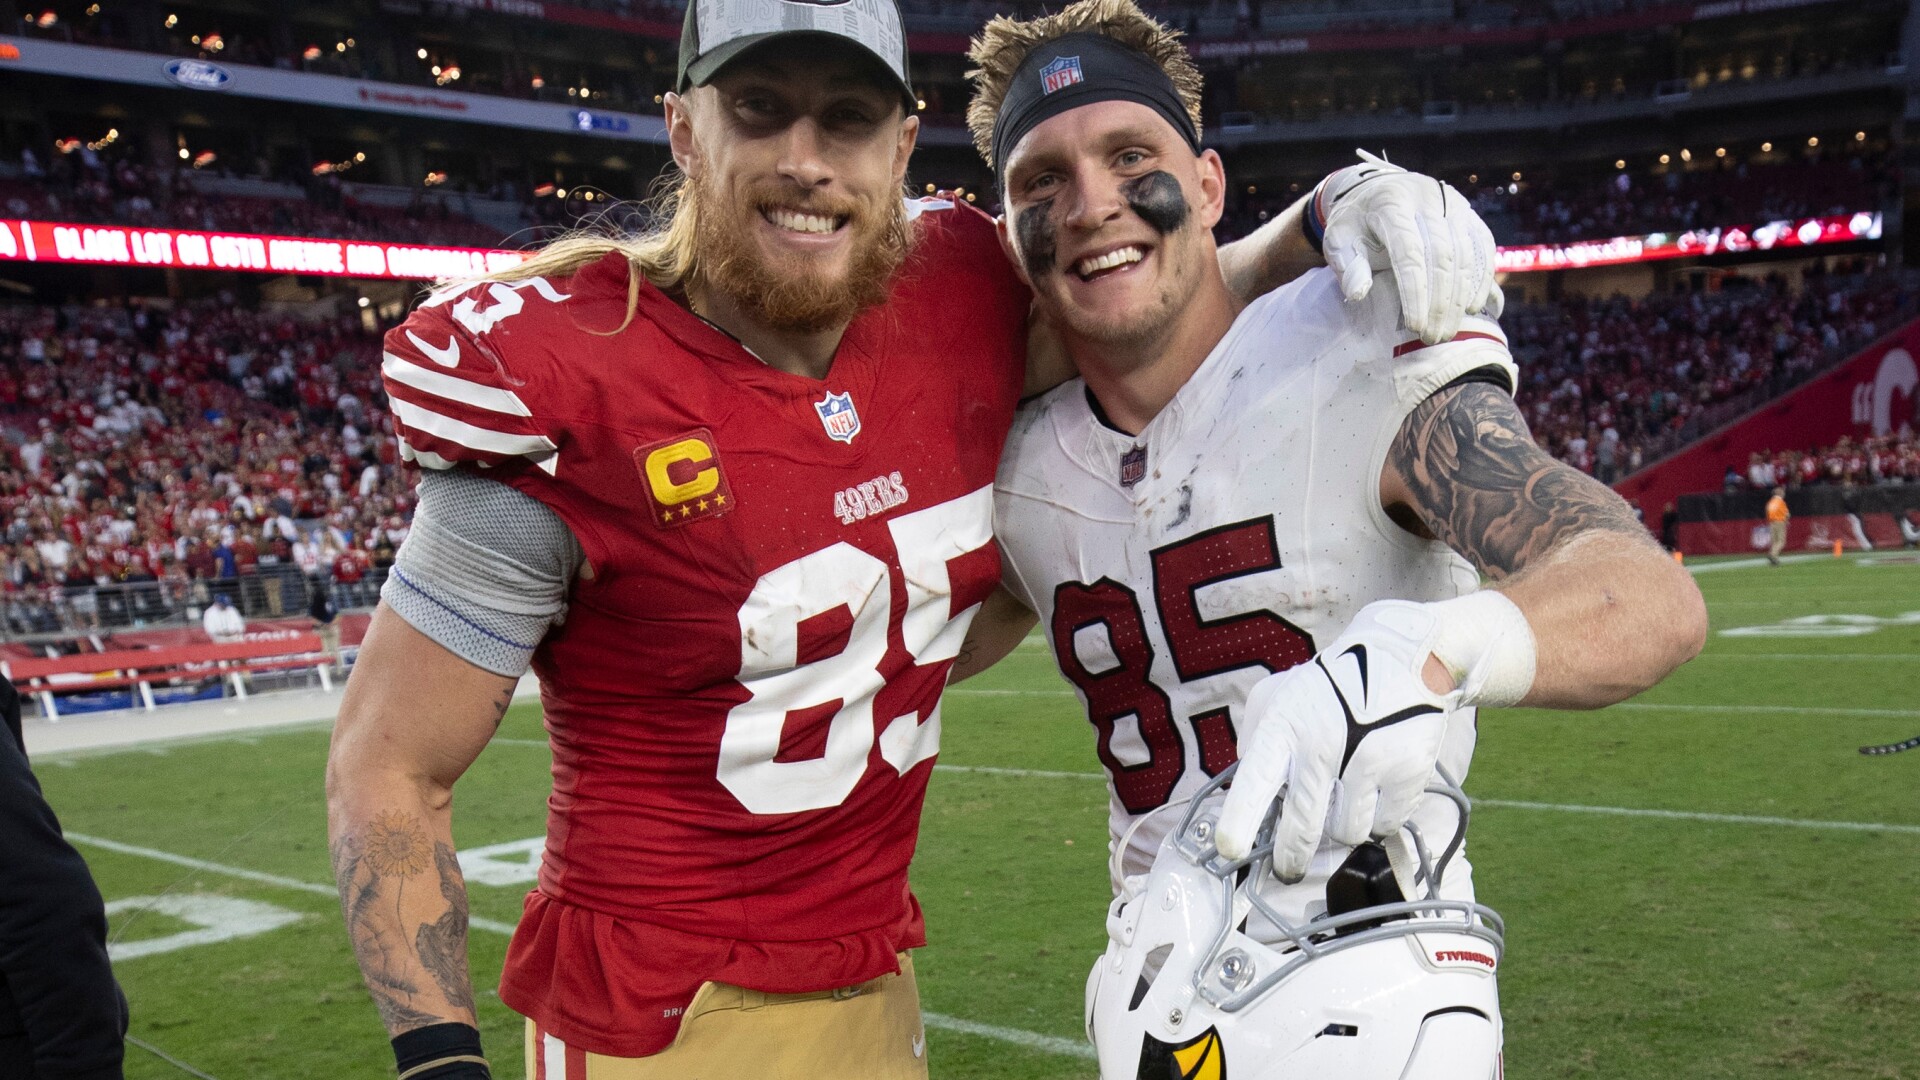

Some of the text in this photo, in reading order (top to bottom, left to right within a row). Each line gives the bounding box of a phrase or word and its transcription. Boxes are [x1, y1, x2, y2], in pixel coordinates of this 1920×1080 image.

[178, 60, 222, 87] Ford
[1045, 68, 1080, 92] NFL
[829, 412, 856, 434] NFL
[645, 438, 719, 506] C
[1122, 462, 1143, 481] NFL
[834, 471, 909, 525] 49ERS
[716, 482, 994, 815] 85
[1051, 514, 1316, 815] 85
[1435, 950, 1495, 968] CARDINALS
[663, 1007, 683, 1018] DRI
